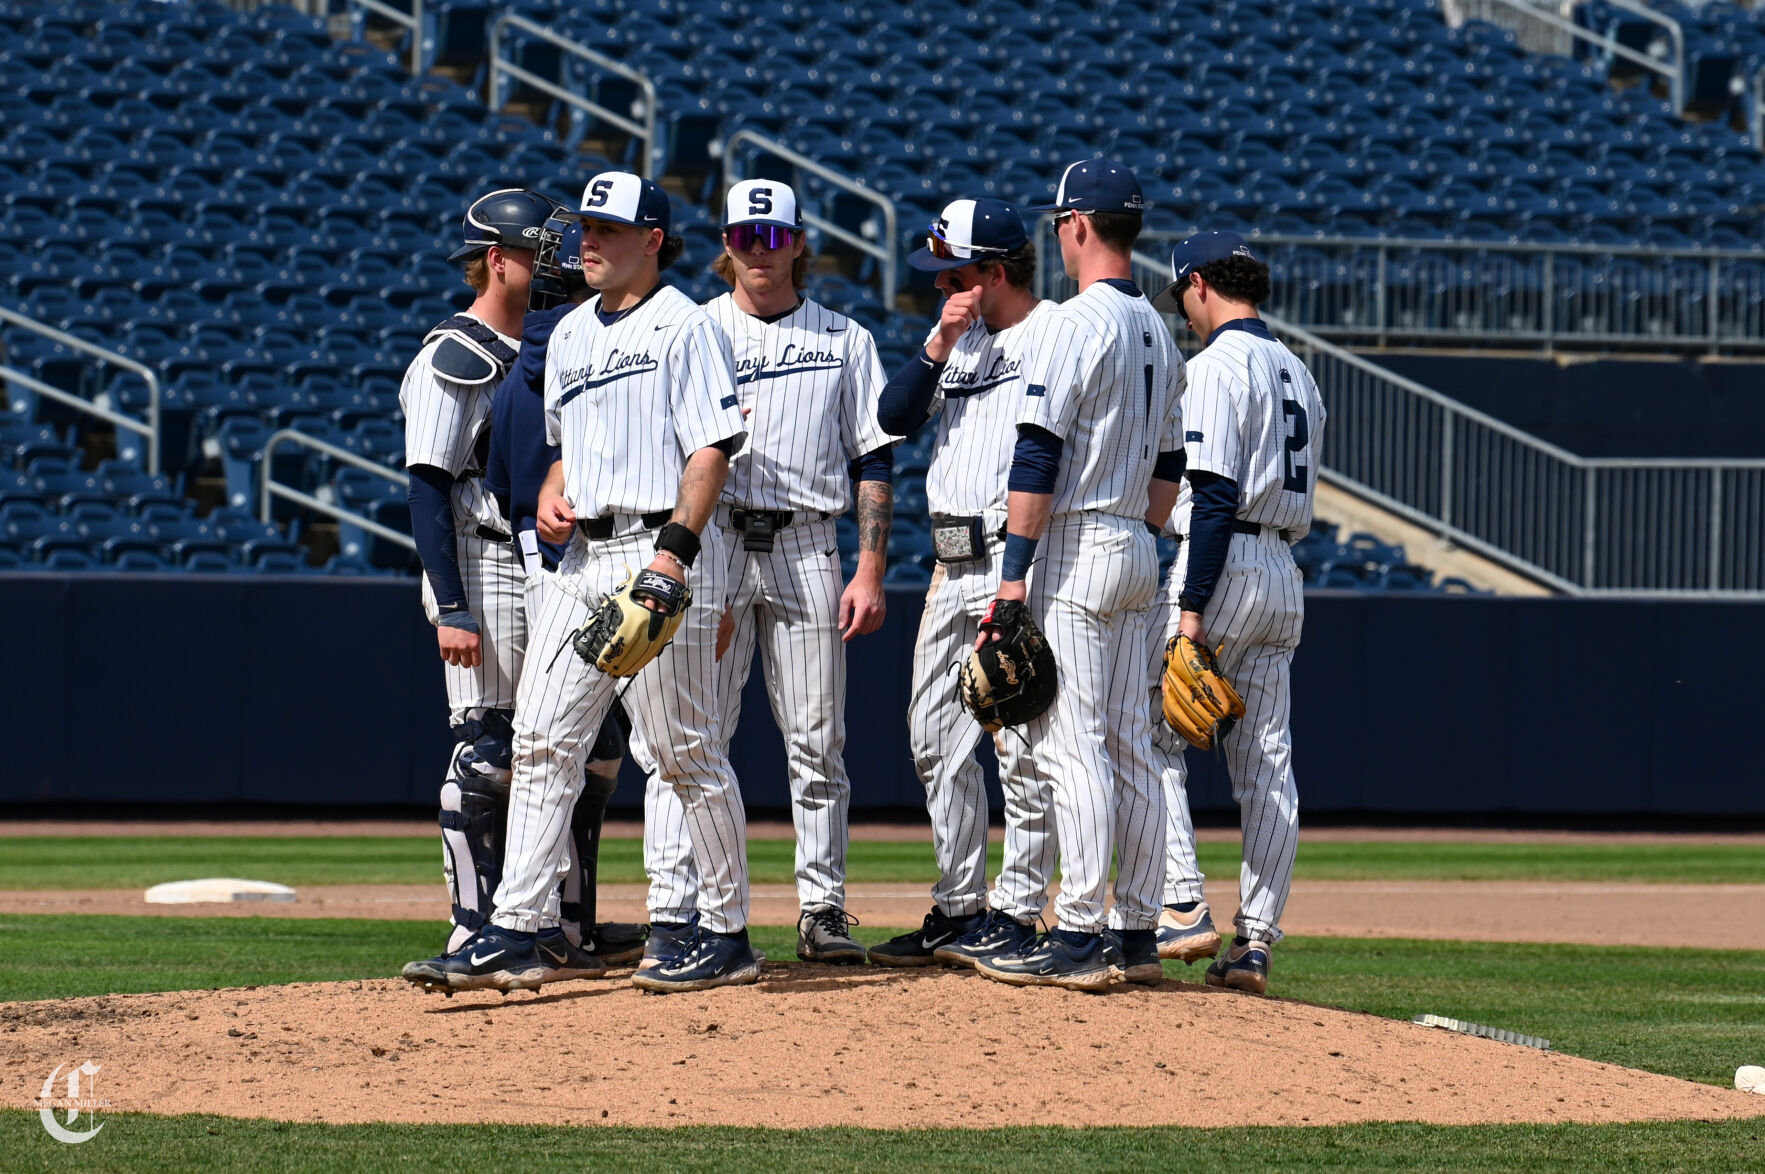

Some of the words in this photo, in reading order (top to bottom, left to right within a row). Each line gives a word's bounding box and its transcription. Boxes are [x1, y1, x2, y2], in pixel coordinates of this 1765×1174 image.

[586, 179, 613, 207] S
[748, 187, 772, 215] S
[599, 348, 655, 375] Lions
[776, 343, 841, 367] Lions
[983, 354, 1021, 381] Lio
[1282, 399, 1309, 494] 2
